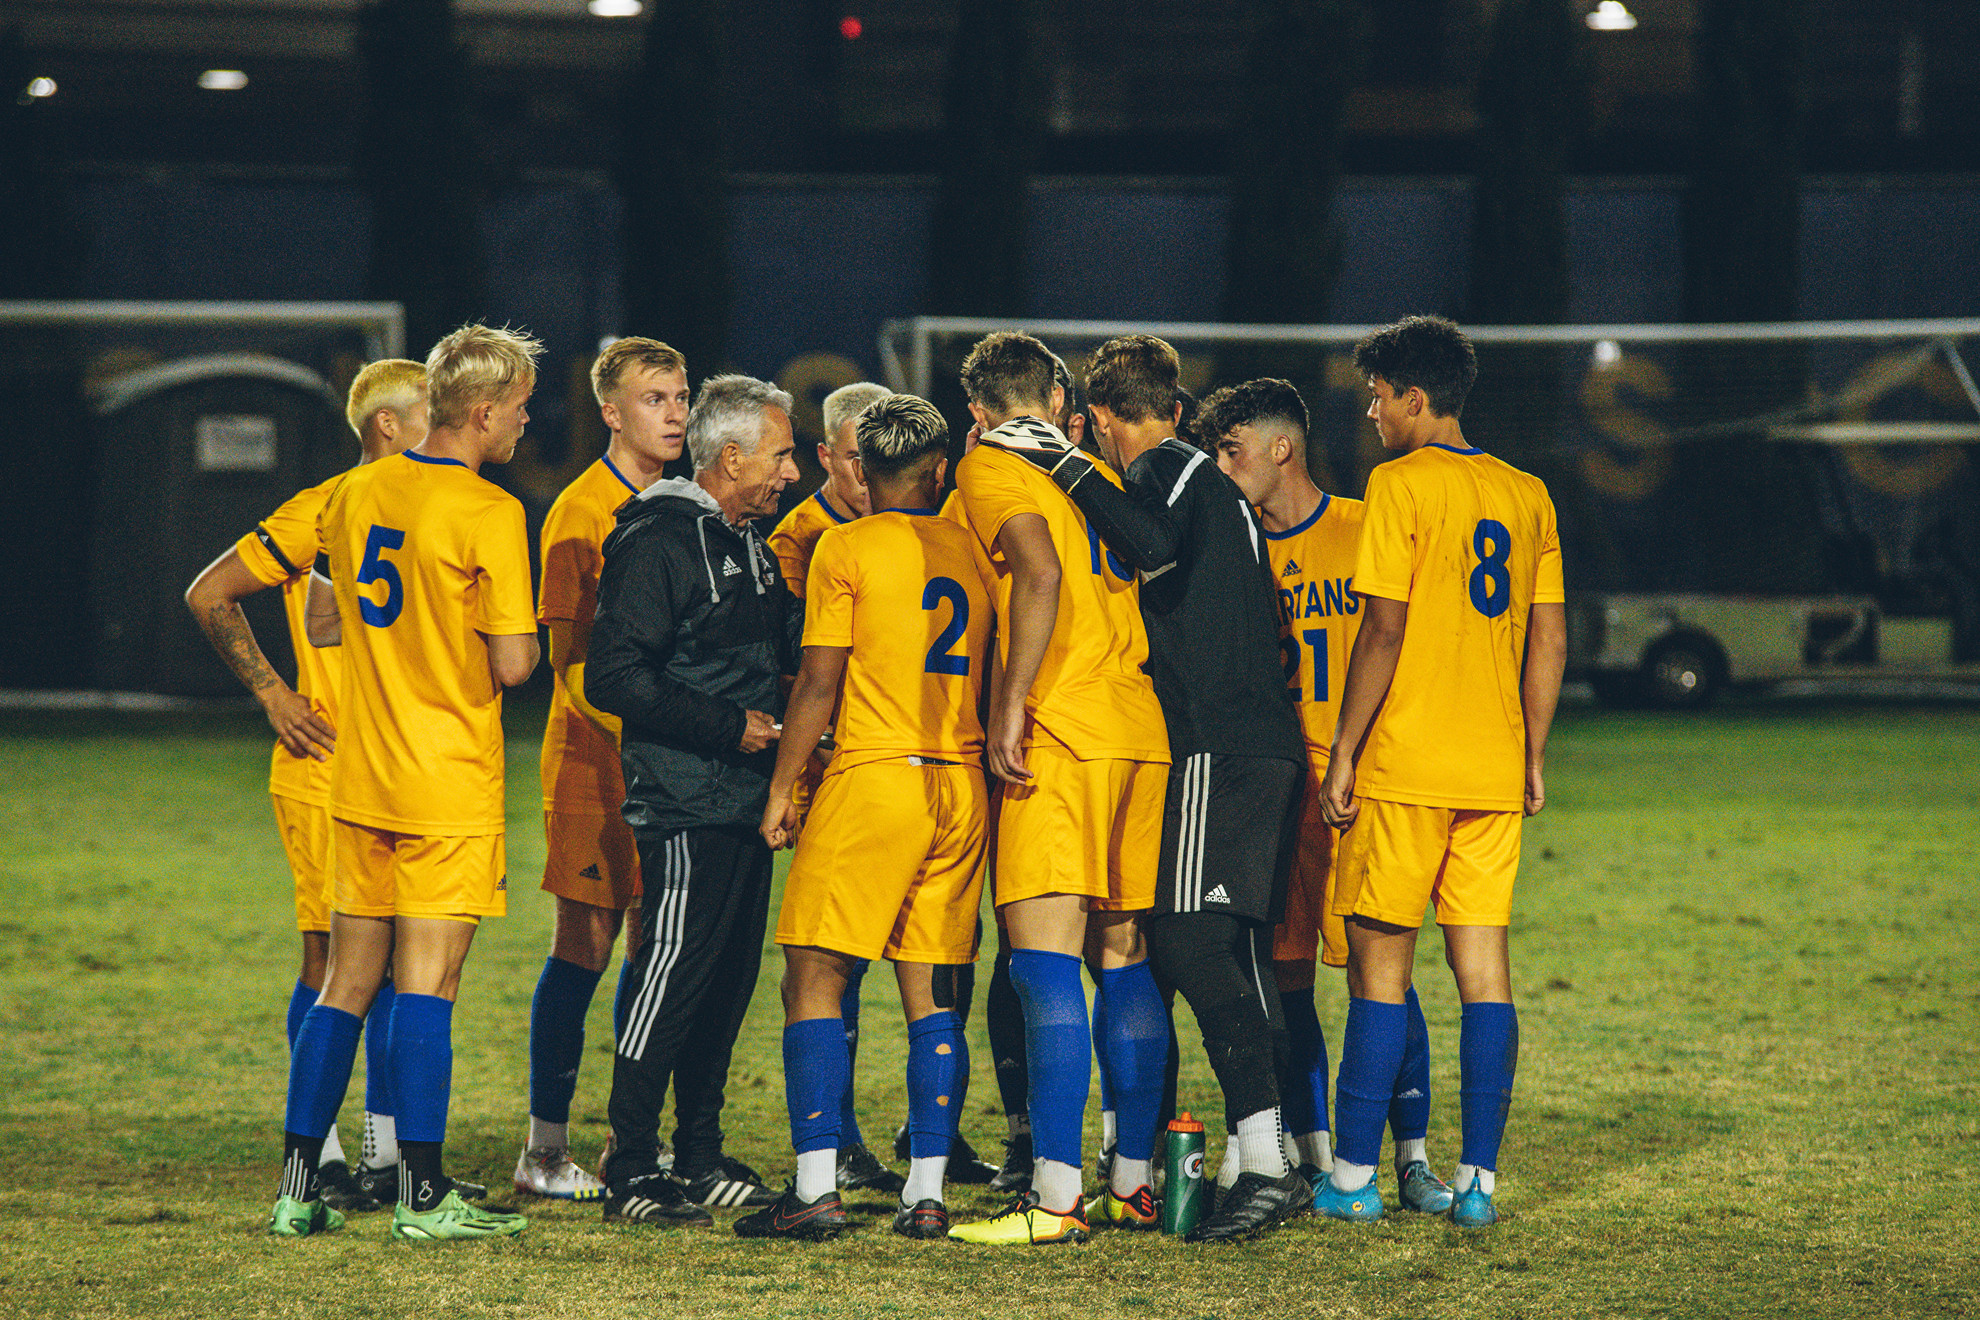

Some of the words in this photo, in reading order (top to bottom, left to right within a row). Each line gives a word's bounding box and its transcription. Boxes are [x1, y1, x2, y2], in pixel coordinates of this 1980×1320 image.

[356, 524, 406, 628] 5
[1085, 518, 1132, 582] 1
[1469, 518, 1511, 618] 8
[922, 576, 970, 676] 2
[1278, 577, 1360, 626] RTANS
[1279, 628, 1329, 702] 21
[1204, 894, 1231, 904] adidas
